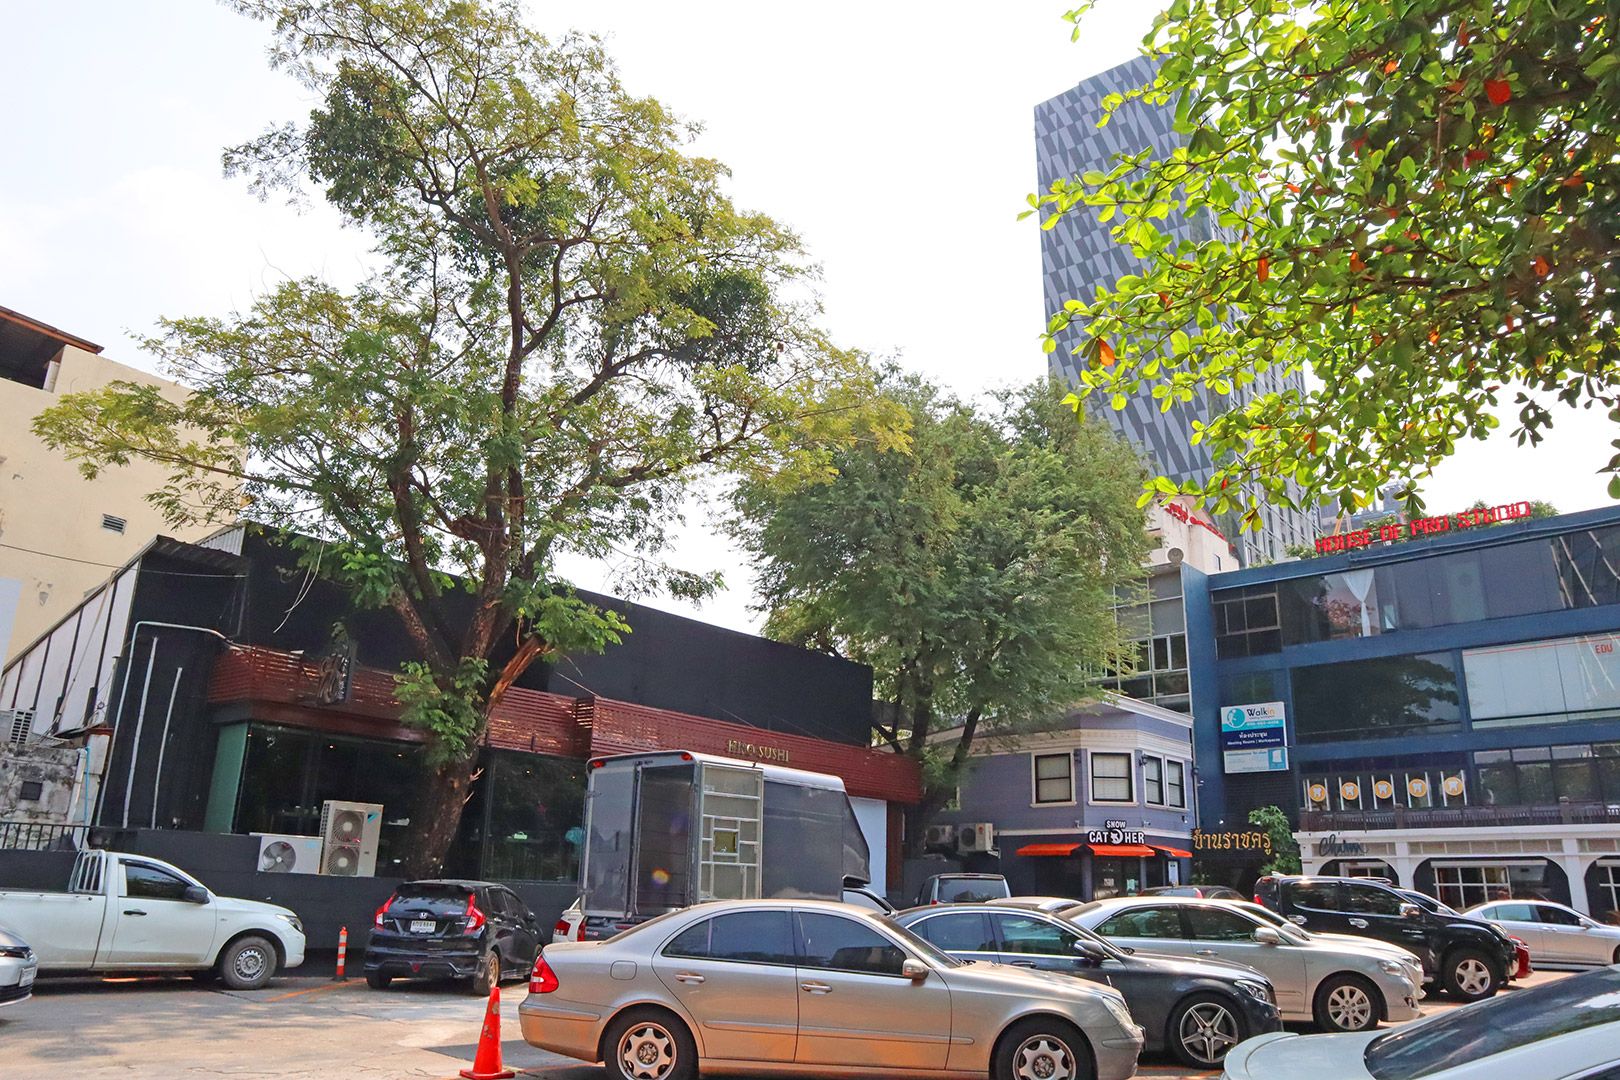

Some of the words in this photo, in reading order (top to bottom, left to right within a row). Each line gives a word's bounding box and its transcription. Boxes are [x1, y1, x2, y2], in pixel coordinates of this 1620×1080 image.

[1315, 527, 1374, 553] HOUSE
[1379, 524, 1404, 542] OF
[1409, 514, 1450, 537] PRO
[1456, 501, 1532, 529] STUDIO
[759, 745, 789, 762] SUSHI
[1105, 819, 1127, 829] SNOW
[1192, 826, 1272, 856] บ้านราชครู
